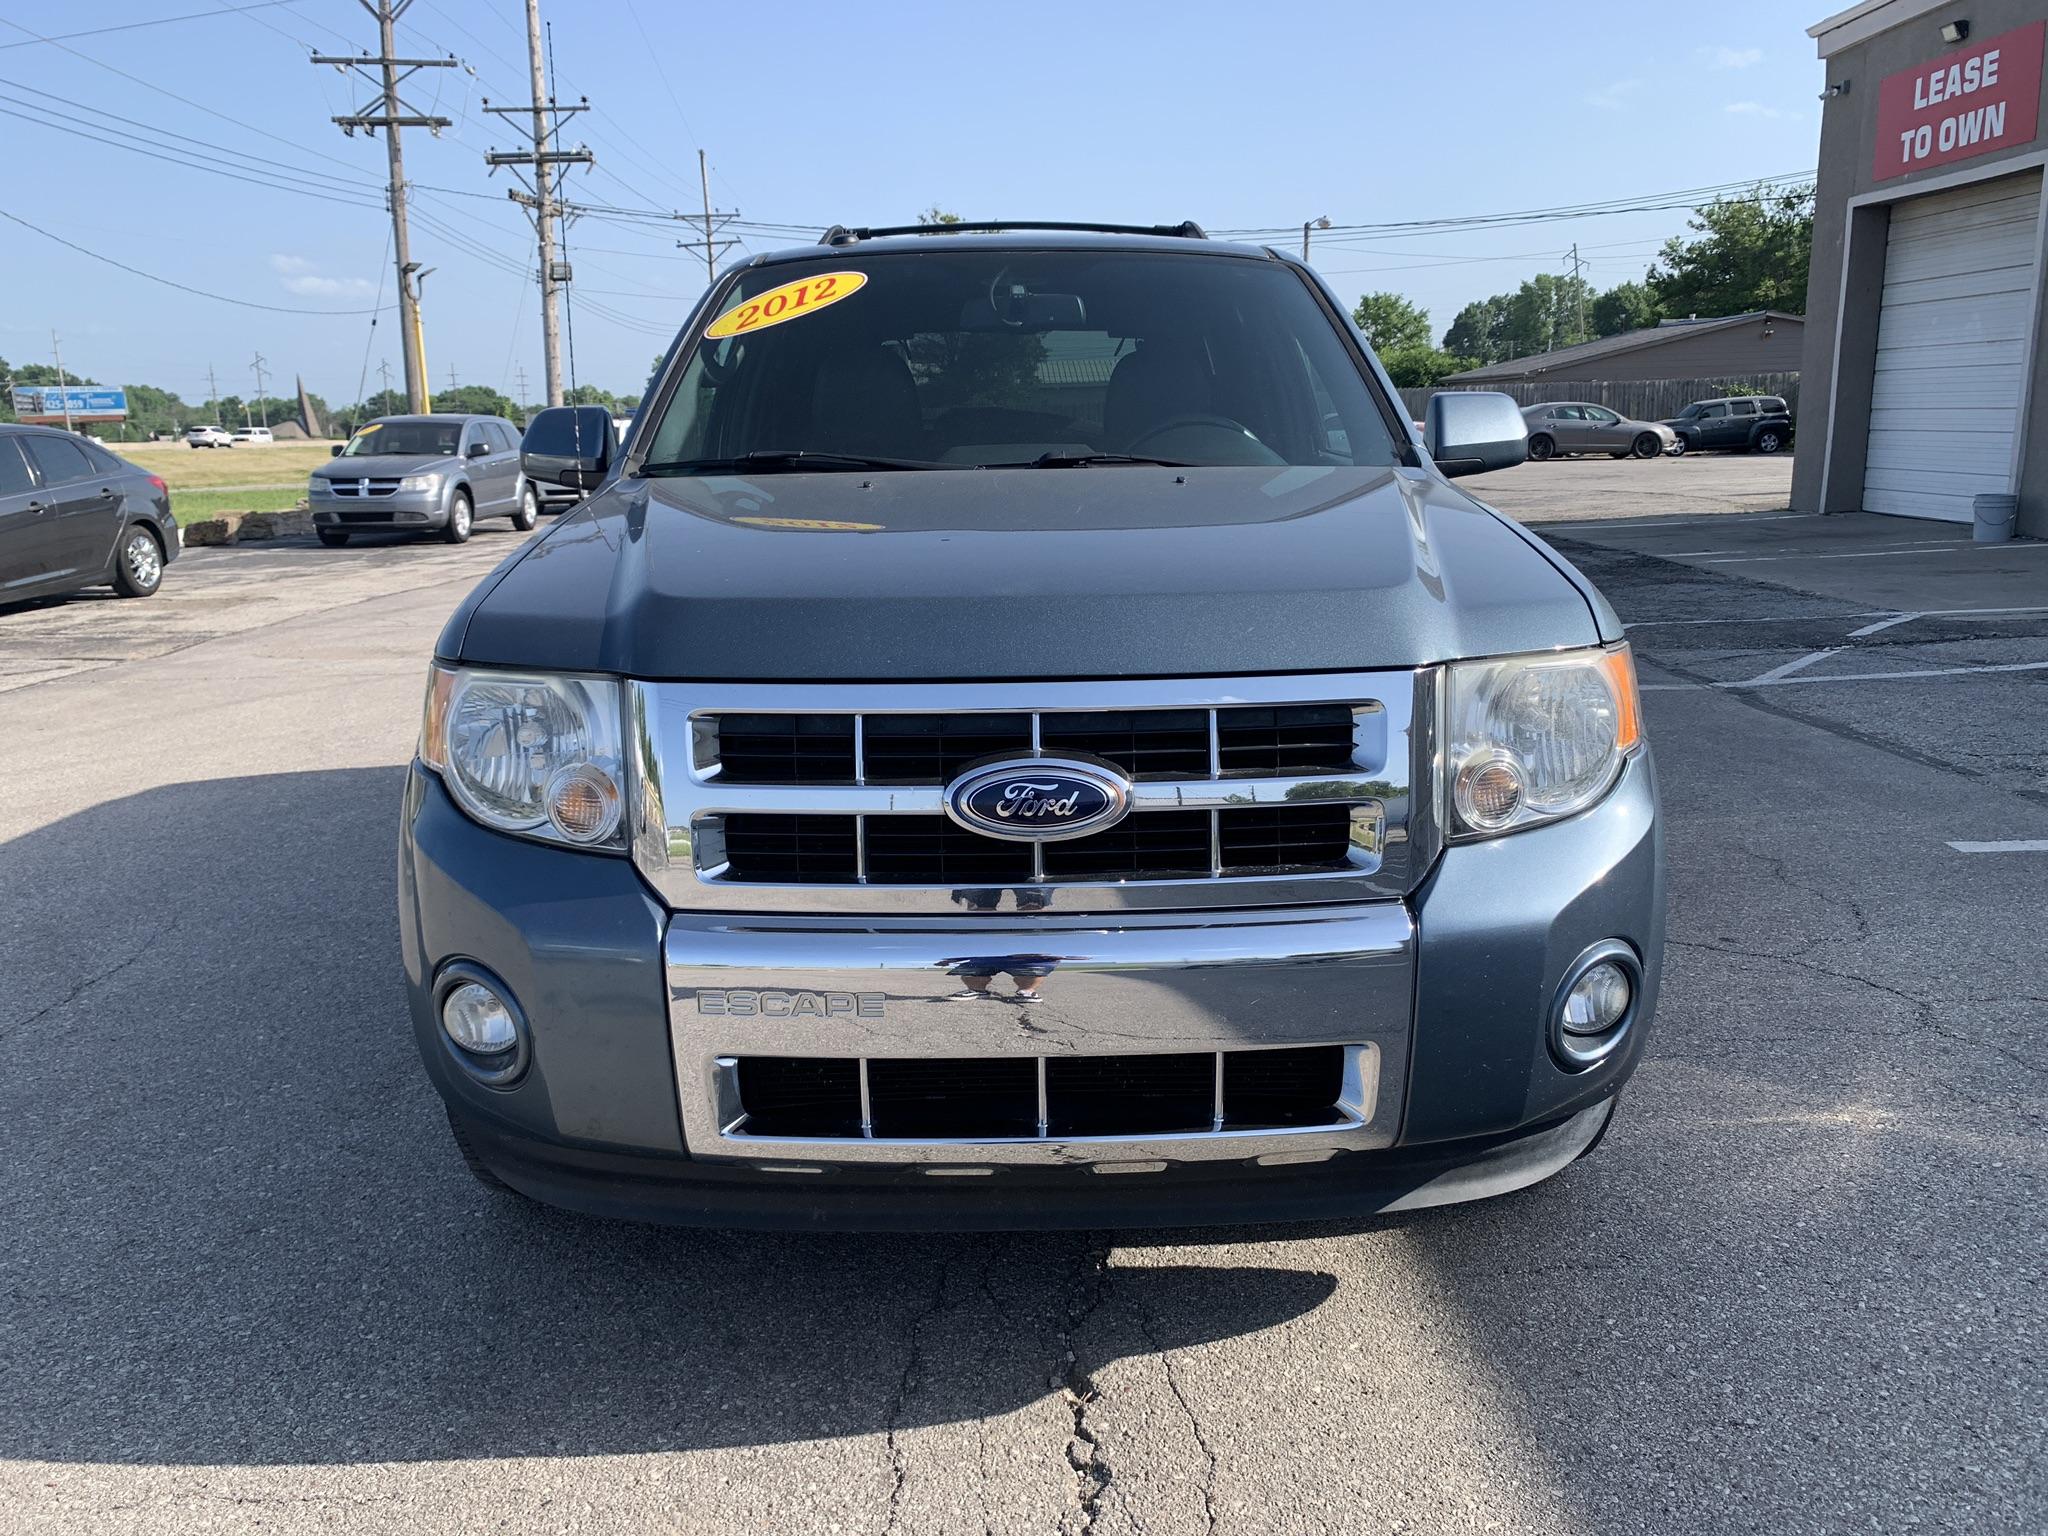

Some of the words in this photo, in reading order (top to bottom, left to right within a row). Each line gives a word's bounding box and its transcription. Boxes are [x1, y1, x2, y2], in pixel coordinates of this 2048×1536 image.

[1914, 49, 2000, 110] LEASE
[1901, 124, 1933, 163] TO
[1938, 101, 2006, 152] OWN
[735, 278, 838, 331] 2012
[995, 782, 1080, 817] Ford
[698, 990, 886, 1018] ESCAPE
